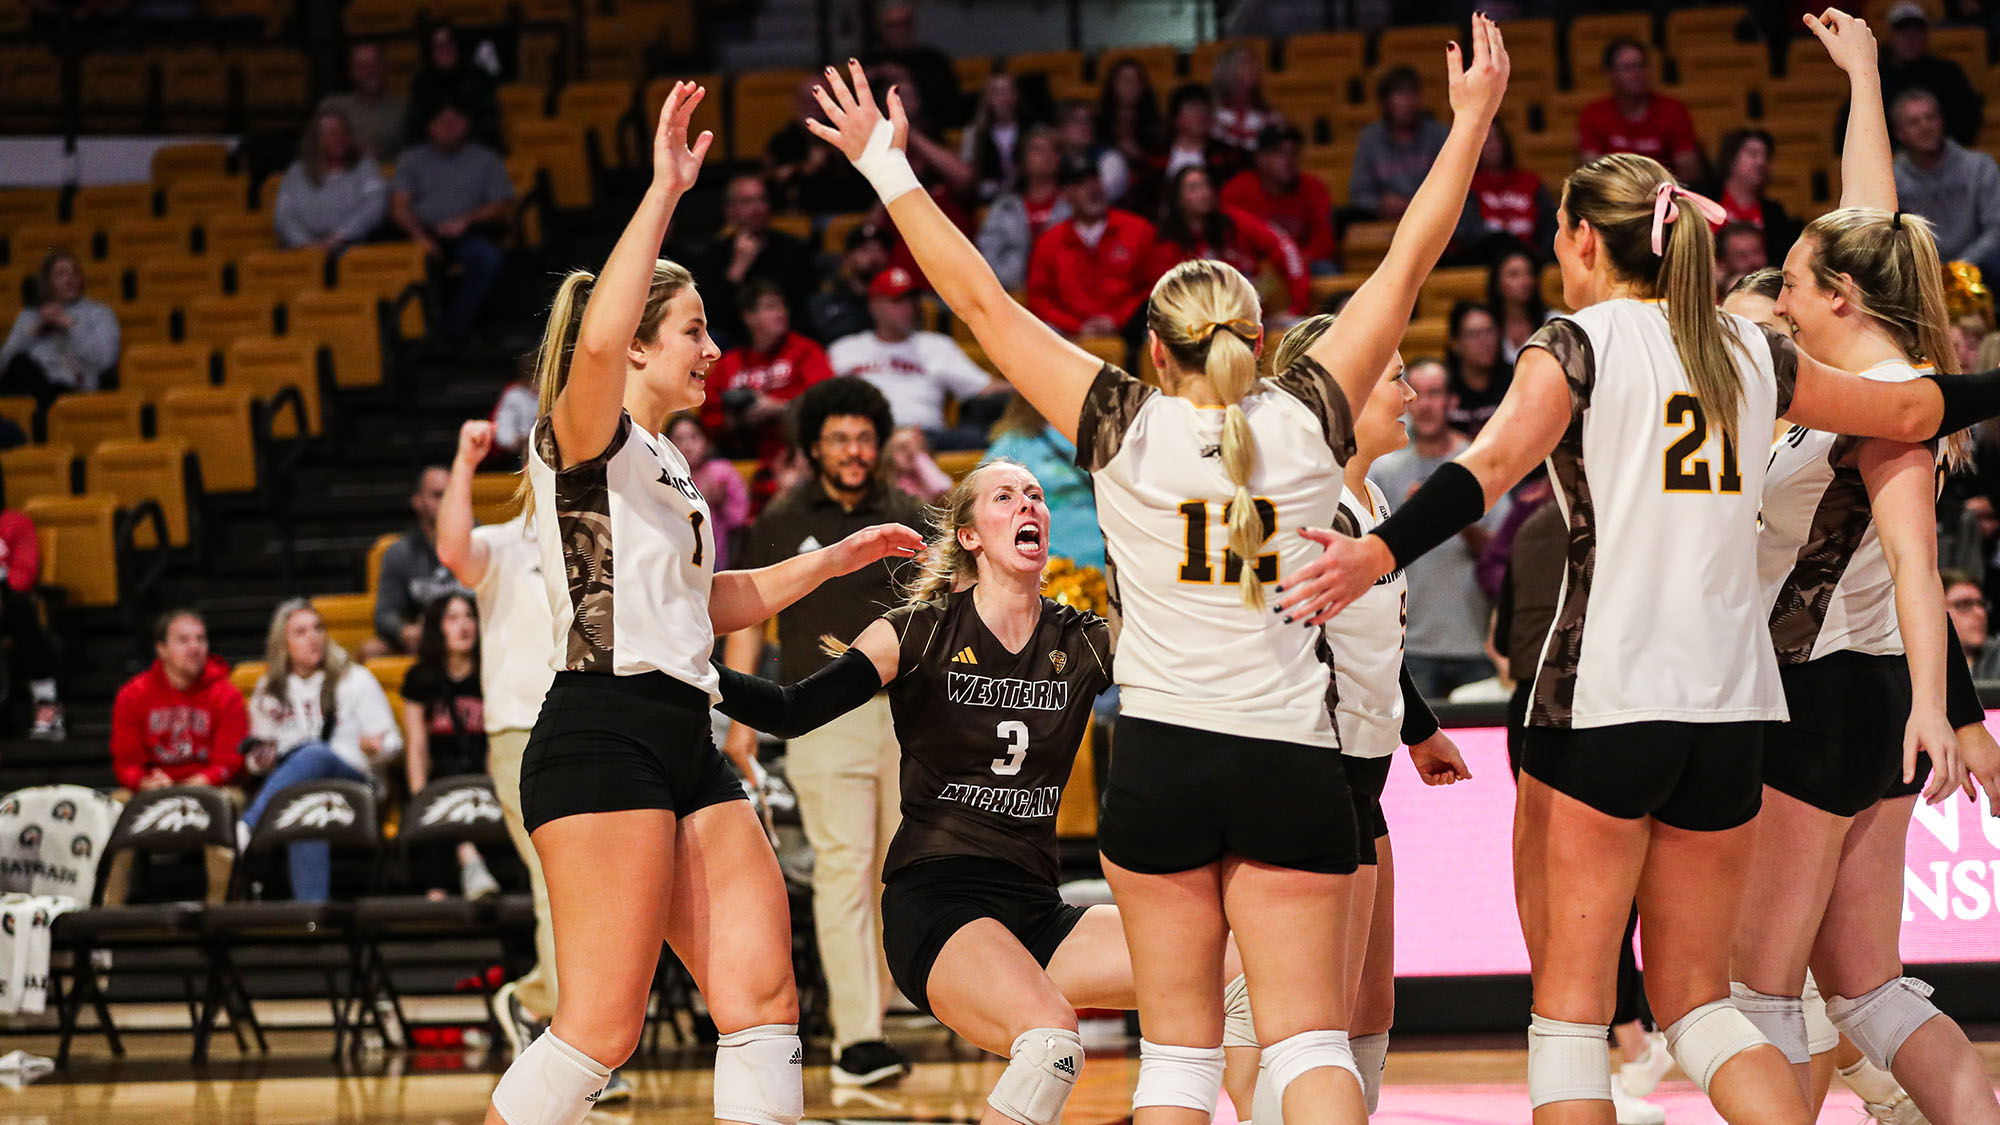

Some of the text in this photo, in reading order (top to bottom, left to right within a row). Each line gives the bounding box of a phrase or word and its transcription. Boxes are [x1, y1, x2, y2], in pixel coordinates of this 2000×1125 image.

[1662, 391, 1743, 495] 21
[688, 510, 704, 568] 1
[1177, 498, 1280, 585] 12
[947, 671, 1068, 711] WESTERN
[990, 720, 1029, 776] 3
[937, 783, 1059, 818] MICHIGAN
[1902, 859, 2000, 922] NS
